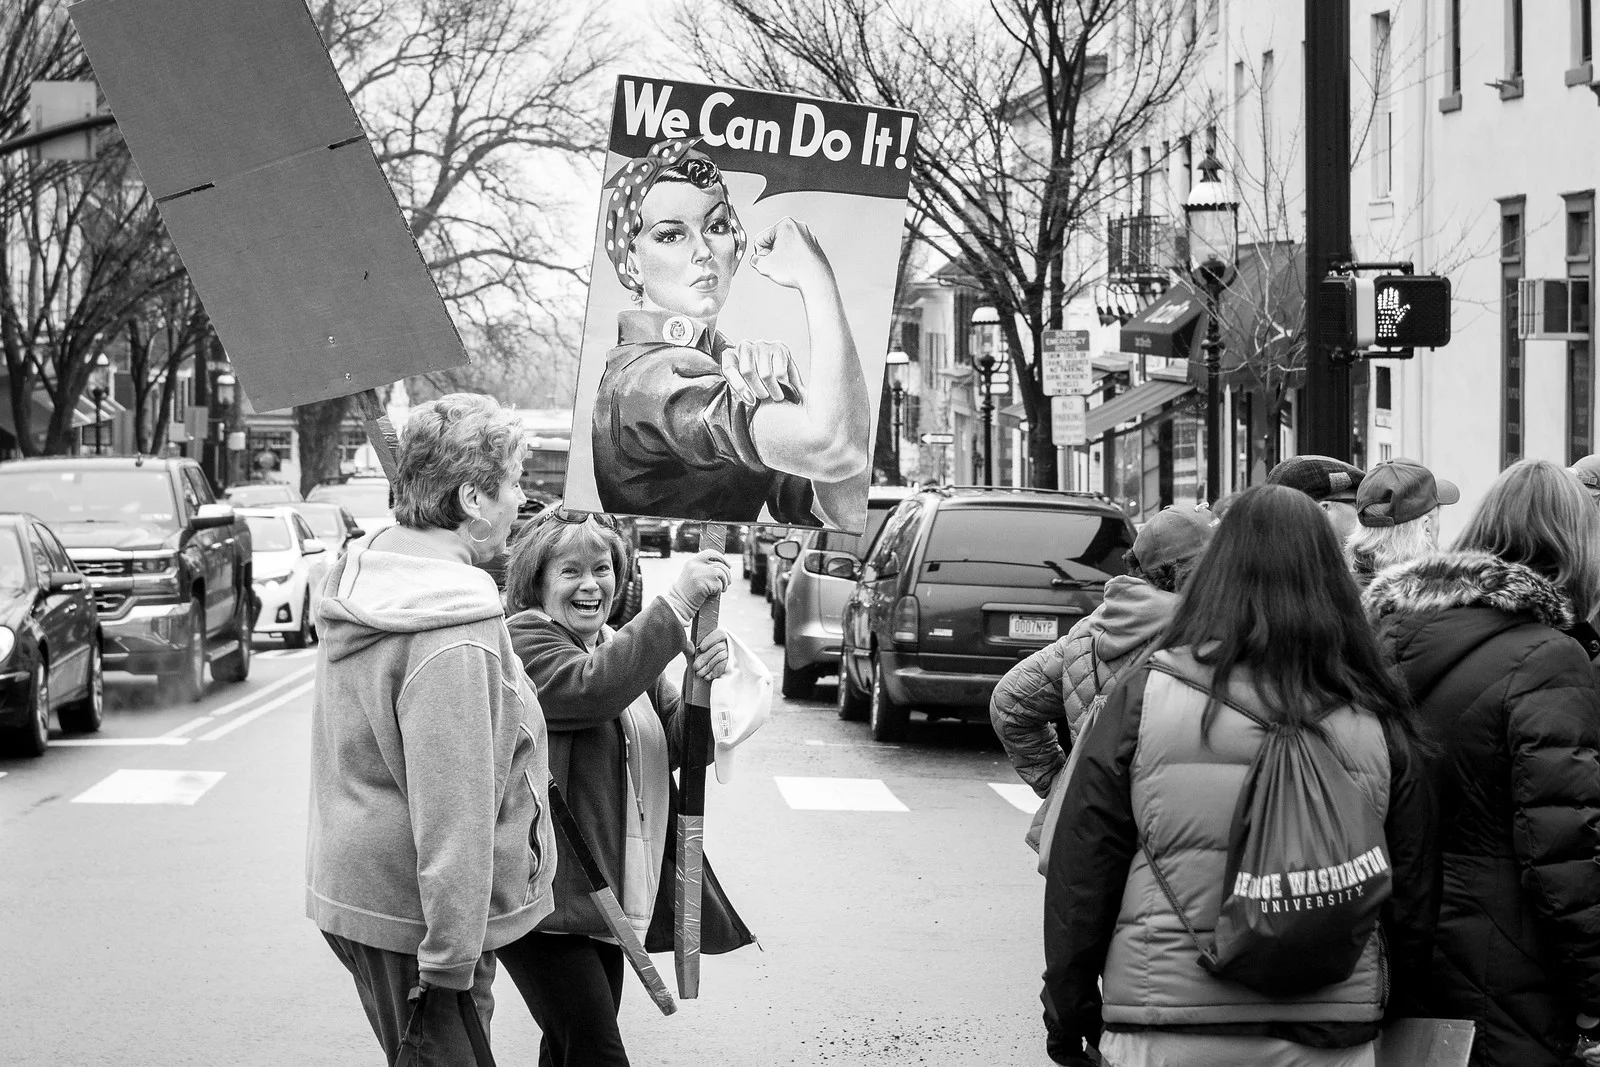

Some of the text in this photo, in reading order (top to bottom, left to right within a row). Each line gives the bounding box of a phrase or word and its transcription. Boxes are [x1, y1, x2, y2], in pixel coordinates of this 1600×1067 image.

[624, 80, 914, 170] We Can Do It!
[1046, 338, 1087, 346] EMERGENCY
[1062, 401, 1073, 410] NO
[1260, 885, 1363, 913] UNIVERSITY
